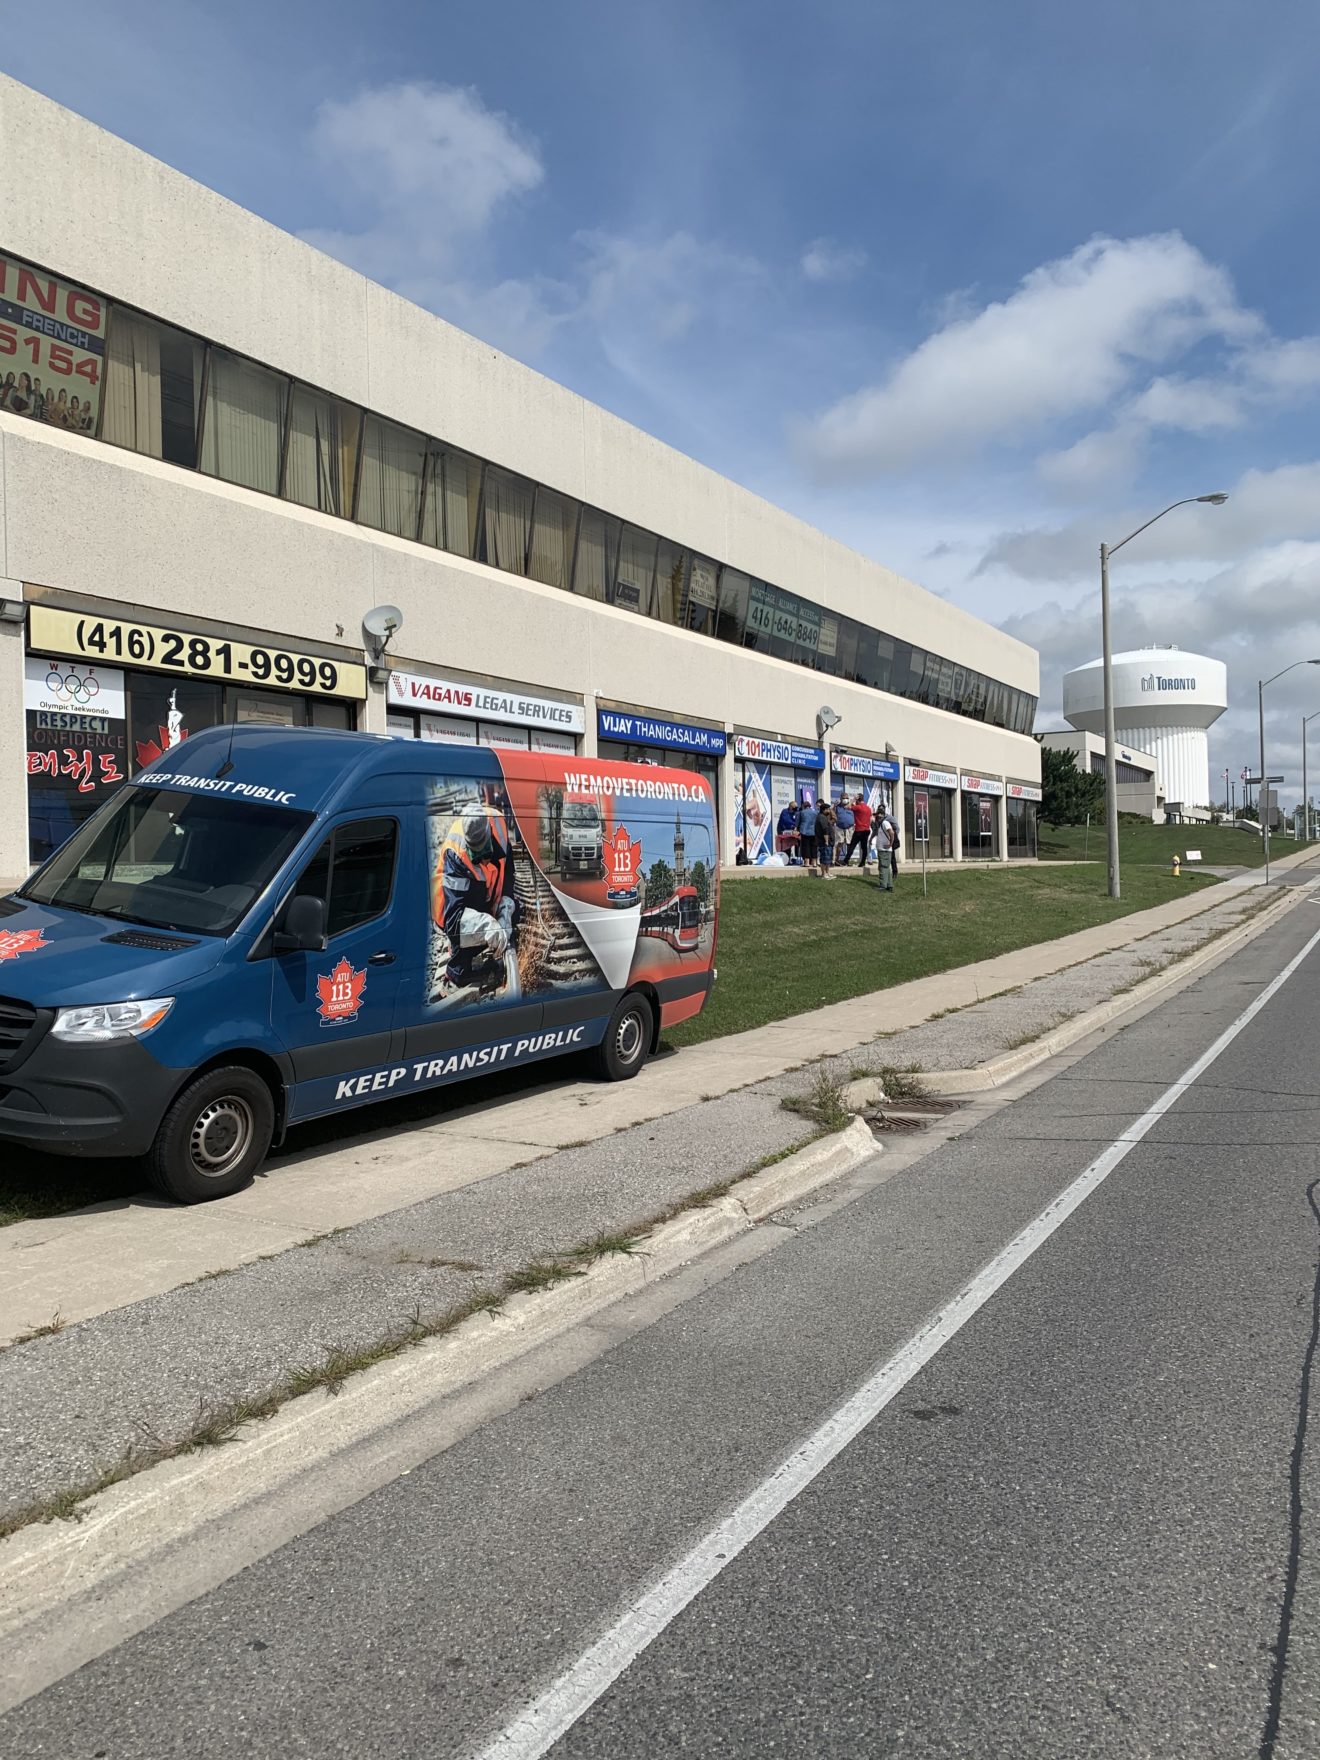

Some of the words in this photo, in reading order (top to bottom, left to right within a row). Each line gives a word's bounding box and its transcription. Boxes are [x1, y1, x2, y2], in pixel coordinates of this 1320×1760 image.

[22, 309, 89, 348] FRENCH
[76, 619, 338, 691] (416)281-9999
[1155, 675, 1196, 691] TORONTO
[40, 701, 69, 711] Olympic
[71, 704, 110, 715] Taekwondo
[410, 681, 473, 707] VAGANS
[475, 694, 515, 715] LEGAL
[517, 701, 573, 724] SERVICES
[40, 712, 108, 732] RESPECT
[602, 714, 632, 735] VIJAY
[635, 721, 710, 748] THANIGASALAM,
[711, 737, 724, 749] MPP
[137, 773, 173, 785] KEEP
[173, 774, 234, 793] TRANSIT
[234, 782, 297, 805] PUBLIC
[563, 772, 707, 803] WEMOVETORONTO.CA
[617, 839, 628, 851] ATU
[614, 852, 632, 872] 113
[612, 875, 634, 883] TORONTO
[336, 972, 350, 983] ATU
[331, 983, 352, 1002] 113
[328, 1002, 354, 1012] TORONTO
[335, 1067, 407, 1100] KEEP
[413, 1044, 510, 1081] TRANSIT
[514, 1026, 586, 1058] PUBLIC
